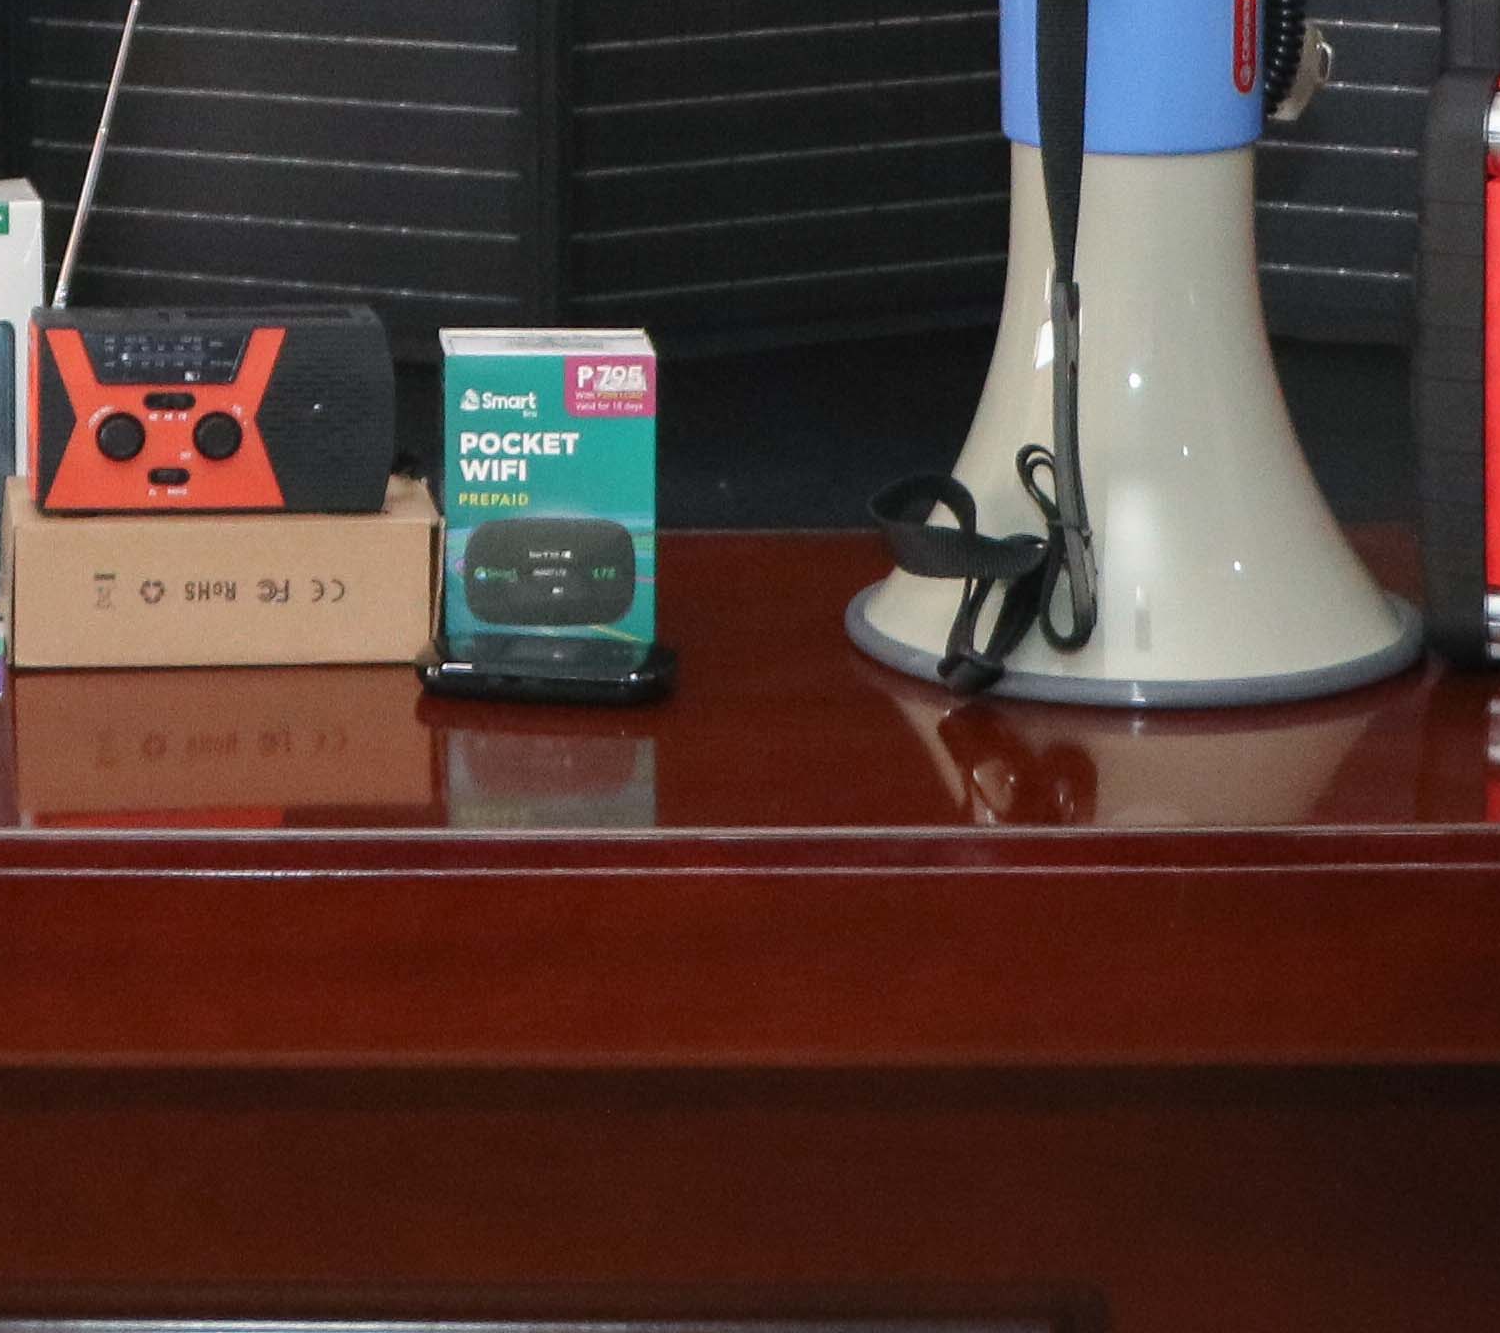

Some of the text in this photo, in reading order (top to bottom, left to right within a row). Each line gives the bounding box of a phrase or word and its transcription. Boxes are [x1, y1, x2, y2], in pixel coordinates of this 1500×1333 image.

[481, 391, 538, 411] Smart
[459, 432, 581, 455] POCKET
[459, 459, 528, 482] WIFI
[459, 492, 529, 507] PREPAID
[184, 580, 237, 603] RoHS
